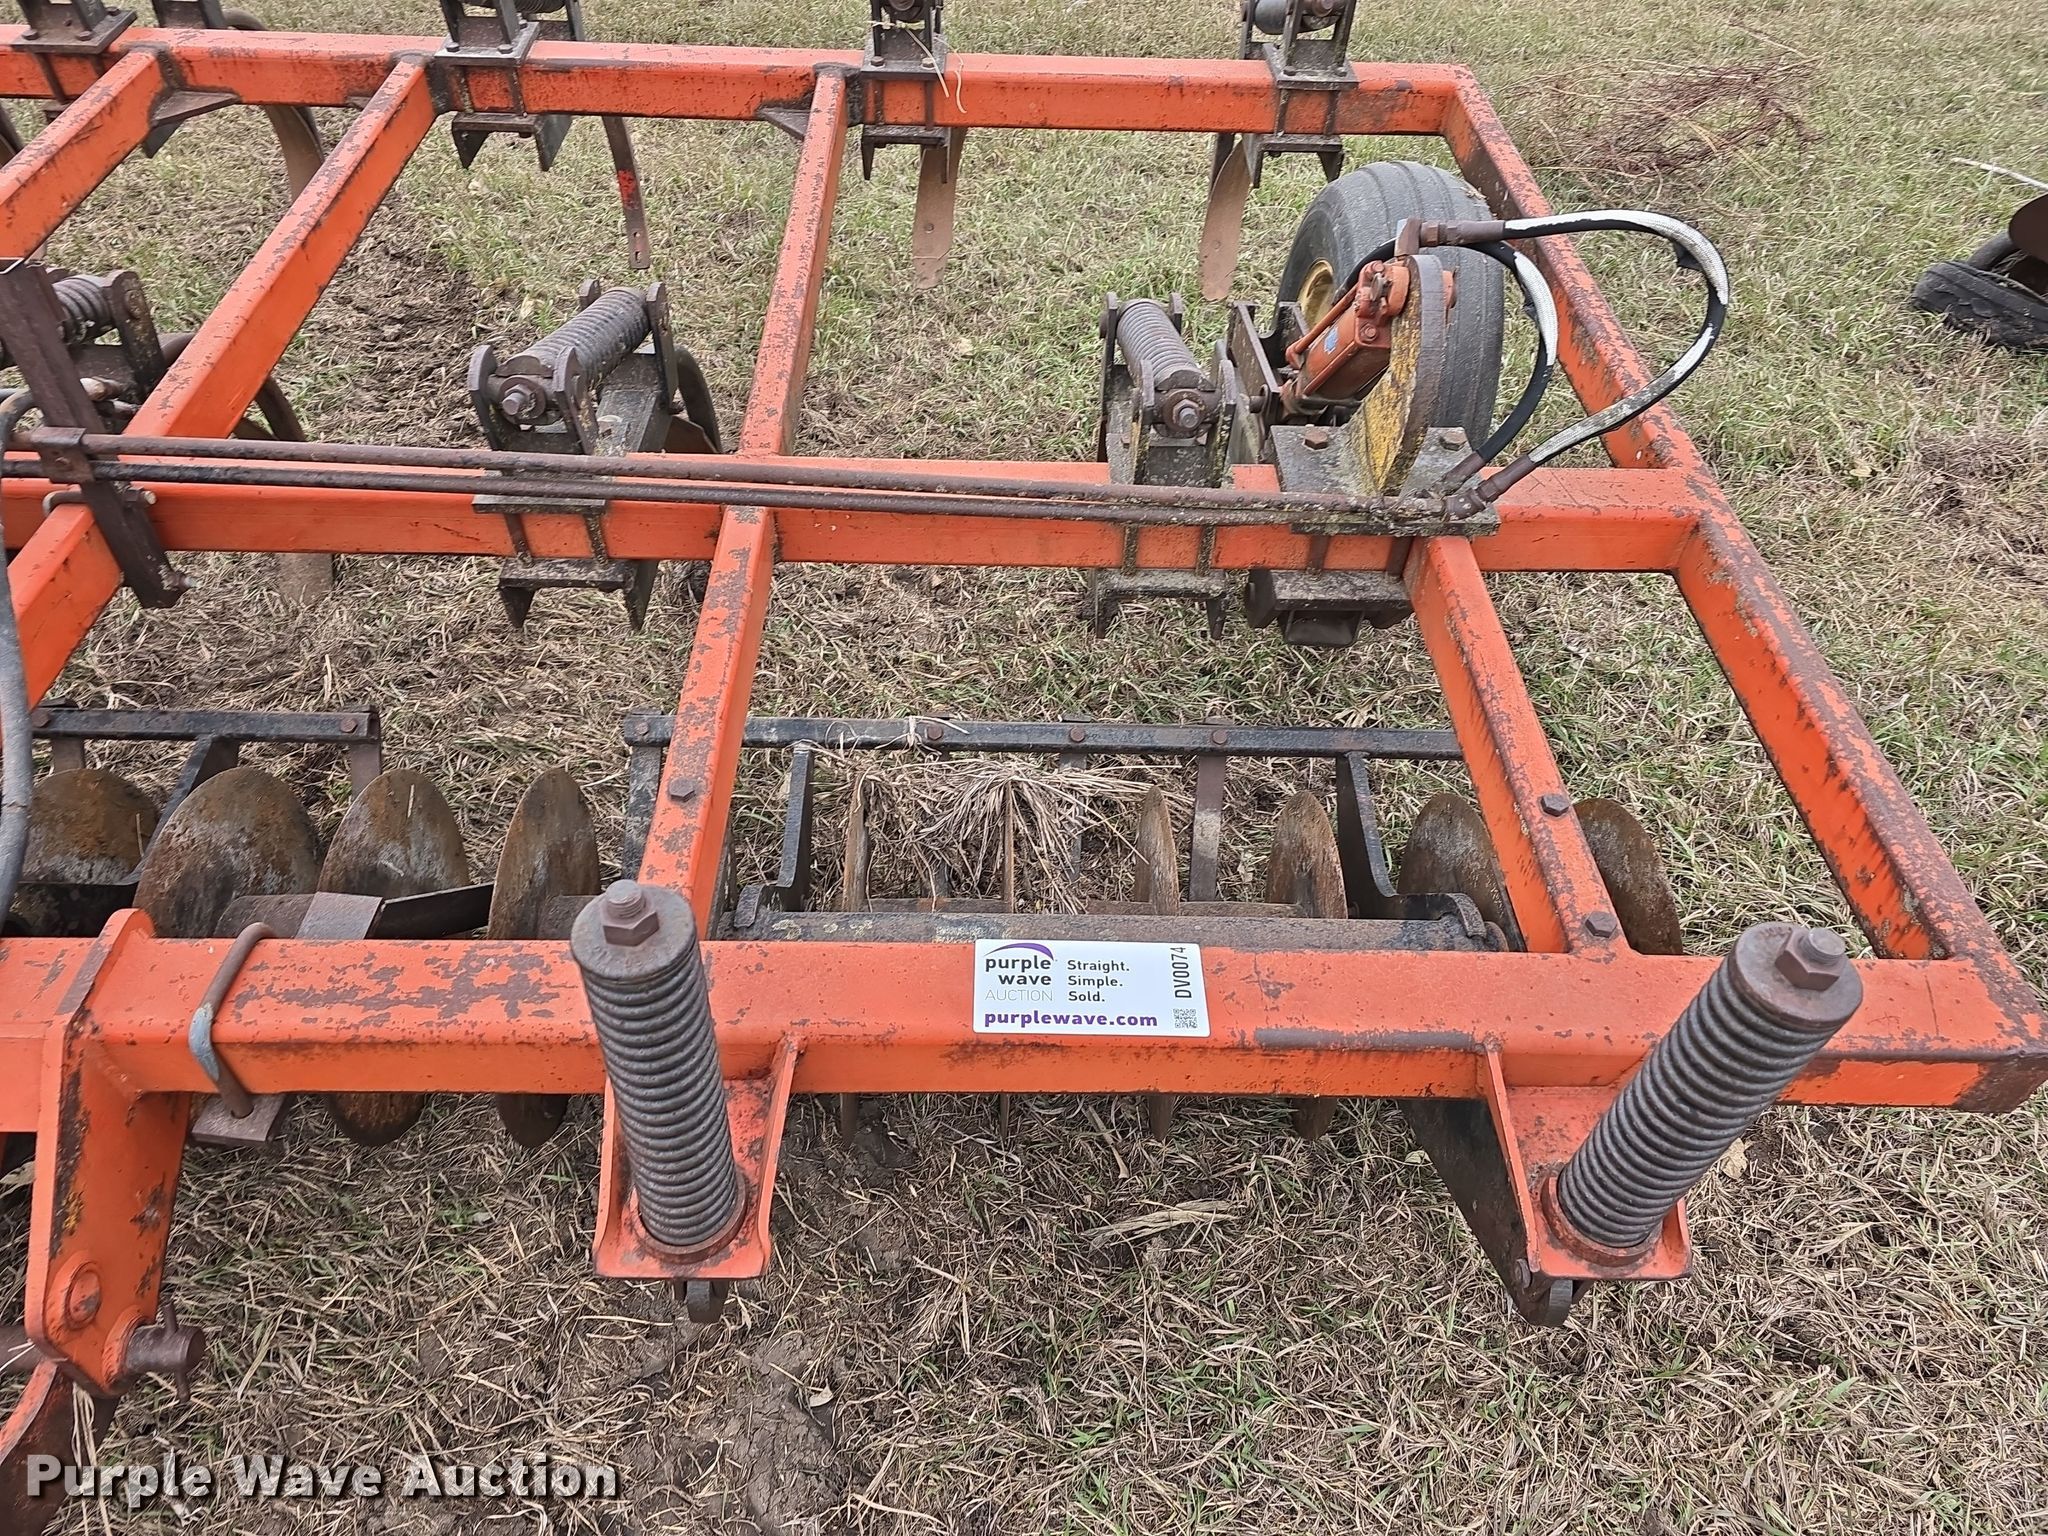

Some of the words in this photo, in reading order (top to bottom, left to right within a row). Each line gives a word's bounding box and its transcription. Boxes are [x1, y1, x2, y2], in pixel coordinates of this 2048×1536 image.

[985, 955, 1051, 973] purple
[1067, 959, 1130, 975] Straight.
[998, 974, 1052, 986] wave
[1170, 946, 1192, 999] DV0074
[1067, 975, 1123, 989] Simple.
[984, 989, 1053, 1002] AUCTION
[1068, 991, 1105, 1002] Sold.
[984, 1010, 1158, 1028] purplewave.com
